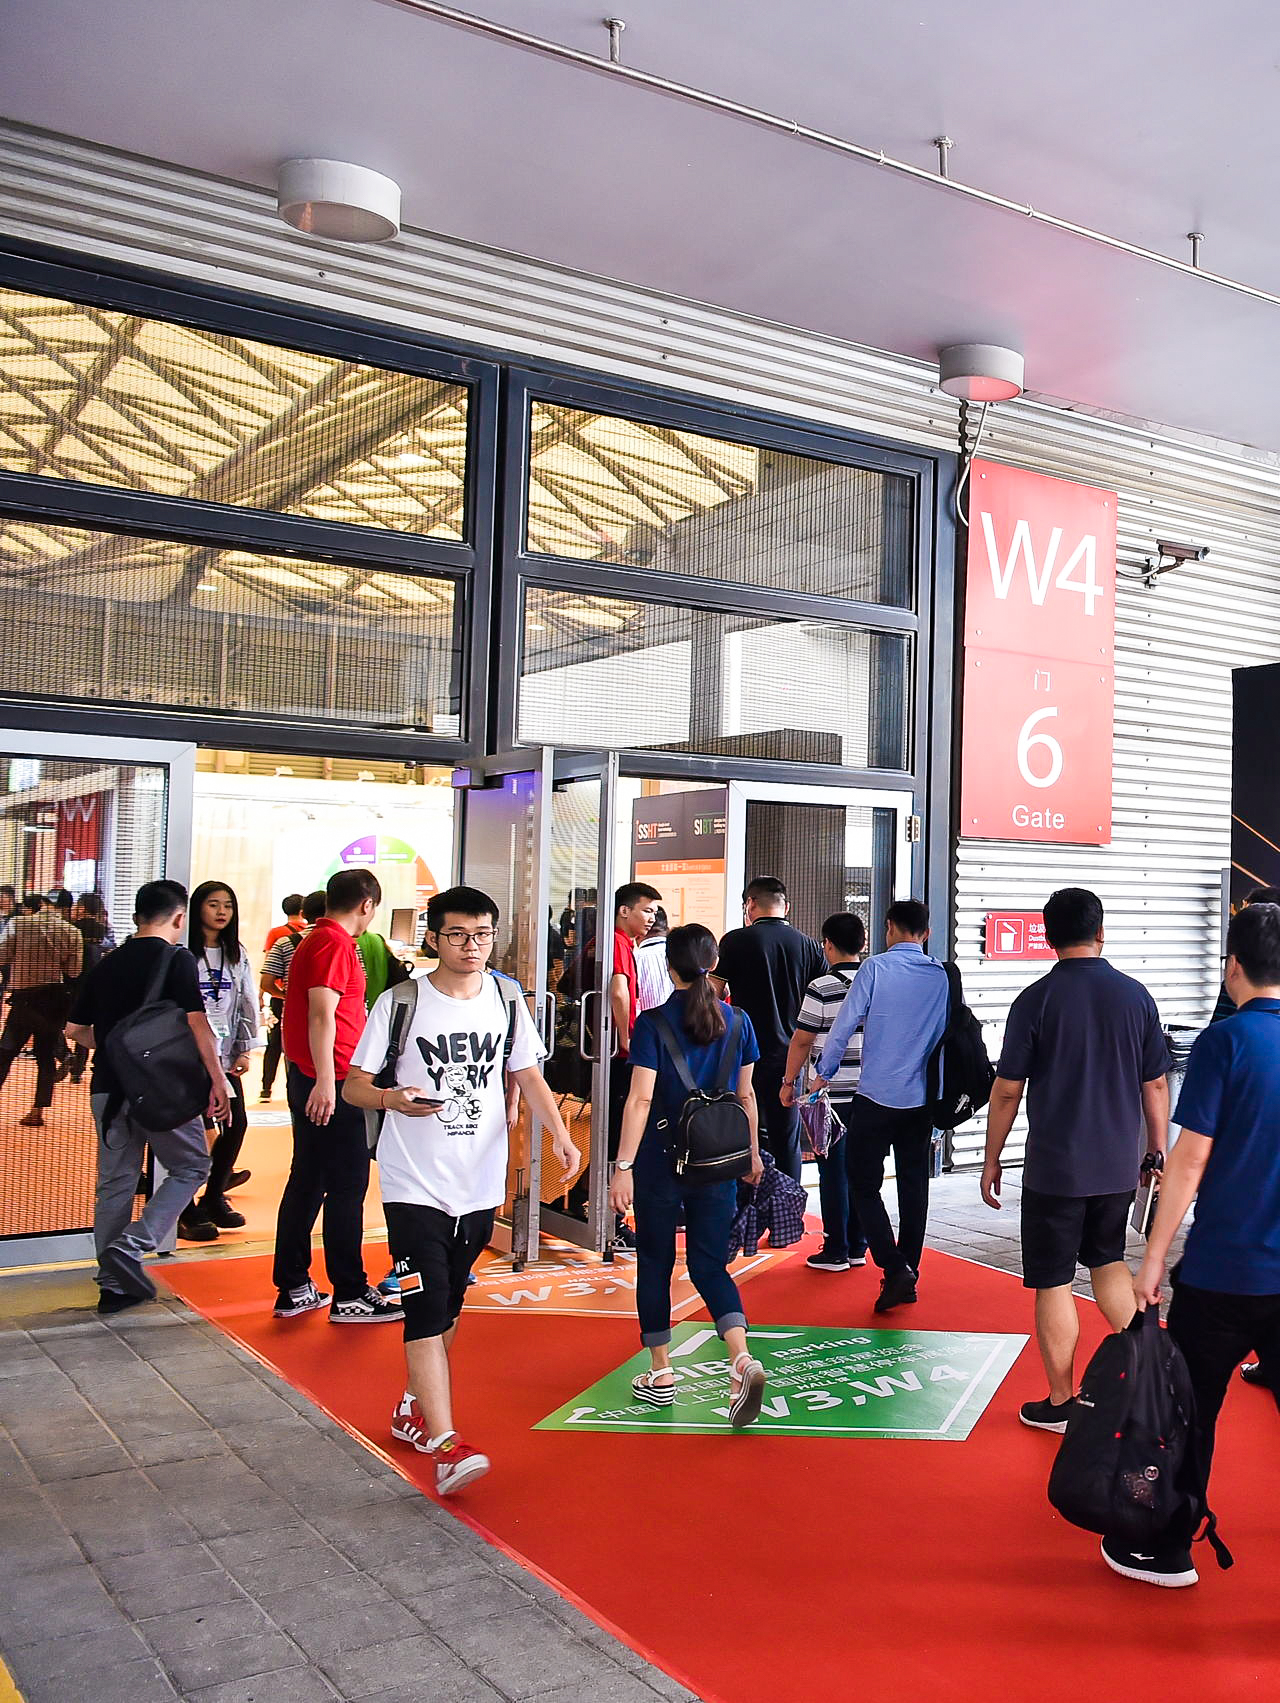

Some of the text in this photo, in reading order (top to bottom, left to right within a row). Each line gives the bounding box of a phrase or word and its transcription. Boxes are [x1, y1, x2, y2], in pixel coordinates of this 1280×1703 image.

[979, 511, 1105, 617] W4
[1016, 706, 1064, 789] 6
[1011, 804, 1066, 830] Gate
[415, 1031, 502, 1067] NEW
[426, 1064, 495, 1092] YRK
[770, 1336, 873, 1359] parking
[796, 1379, 837, 1391] HALL
